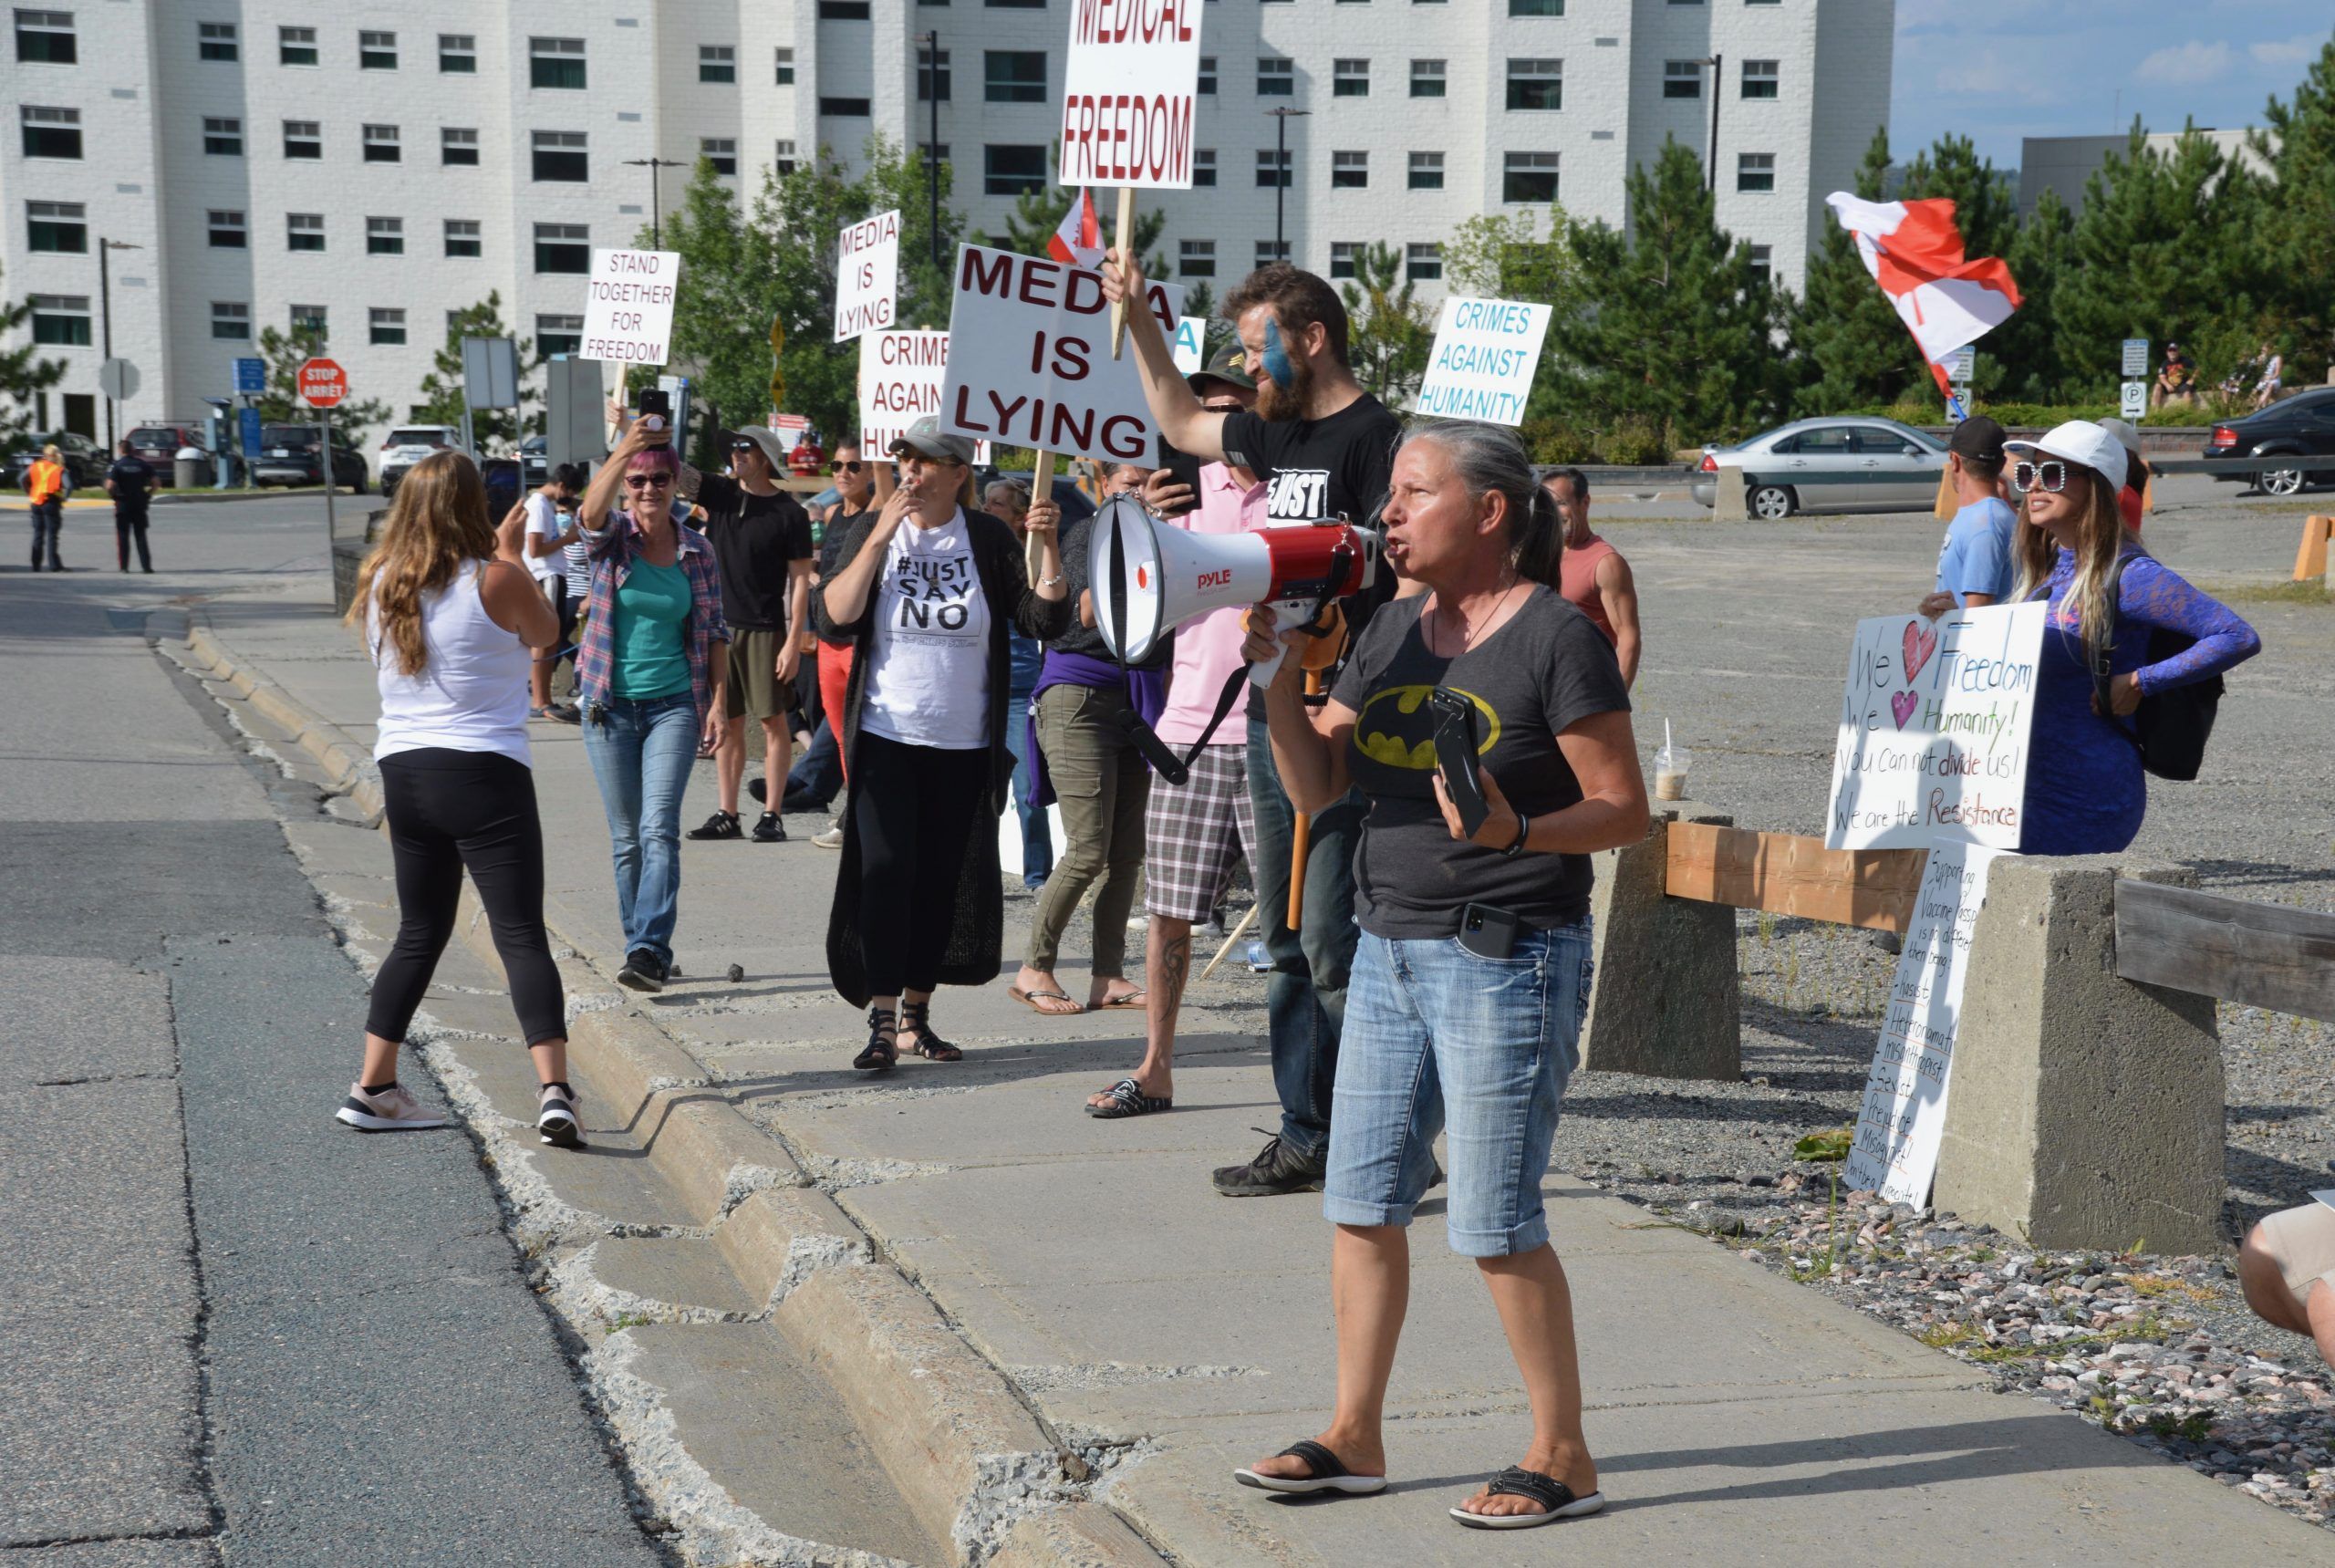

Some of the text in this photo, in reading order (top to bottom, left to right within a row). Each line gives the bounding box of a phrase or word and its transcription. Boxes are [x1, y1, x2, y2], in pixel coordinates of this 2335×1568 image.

[1076, 0, 1192, 46] MEDICAL
[1063, 94, 1191, 182] FREEDOM
[841, 214, 897, 257] MEDIA
[609, 254, 659, 275] STAND
[857, 263, 873, 291] IS
[592, 281, 672, 305] TOGETHER
[961, 248, 1175, 332] MEDA
[611, 311, 642, 331] FOR
[839, 297, 889, 337] LYING
[1455, 301, 1531, 335] CRIMES
[587, 338, 661, 362] FREEDOM
[881, 335, 950, 366] CRIME
[1031, 330, 1091, 381] IS
[1437, 343, 1528, 379] AGAINST
[304, 381, 344, 398] ARRÊT
[306, 368, 338, 381] STOP
[873, 381, 942, 413] AGAIN
[1418, 383, 1524, 422] HUMANITY
[954, 384, 1147, 459] LYING
[898, 556, 969, 582] #JUST
[898, 578, 970, 603] SAY
[900, 597, 969, 630] NO
[1856, 610, 2032, 693] We Freedom
[1847, 691, 2018, 754] We Humanity!
[1938, 741, 1981, 776] divide
[1835, 791, 1861, 831] We
[1865, 812, 1888, 828] are
[1895, 800, 1918, 827] the
[1920, 888, 1953, 921] Vaccine
[1918, 929, 1927, 940] is
